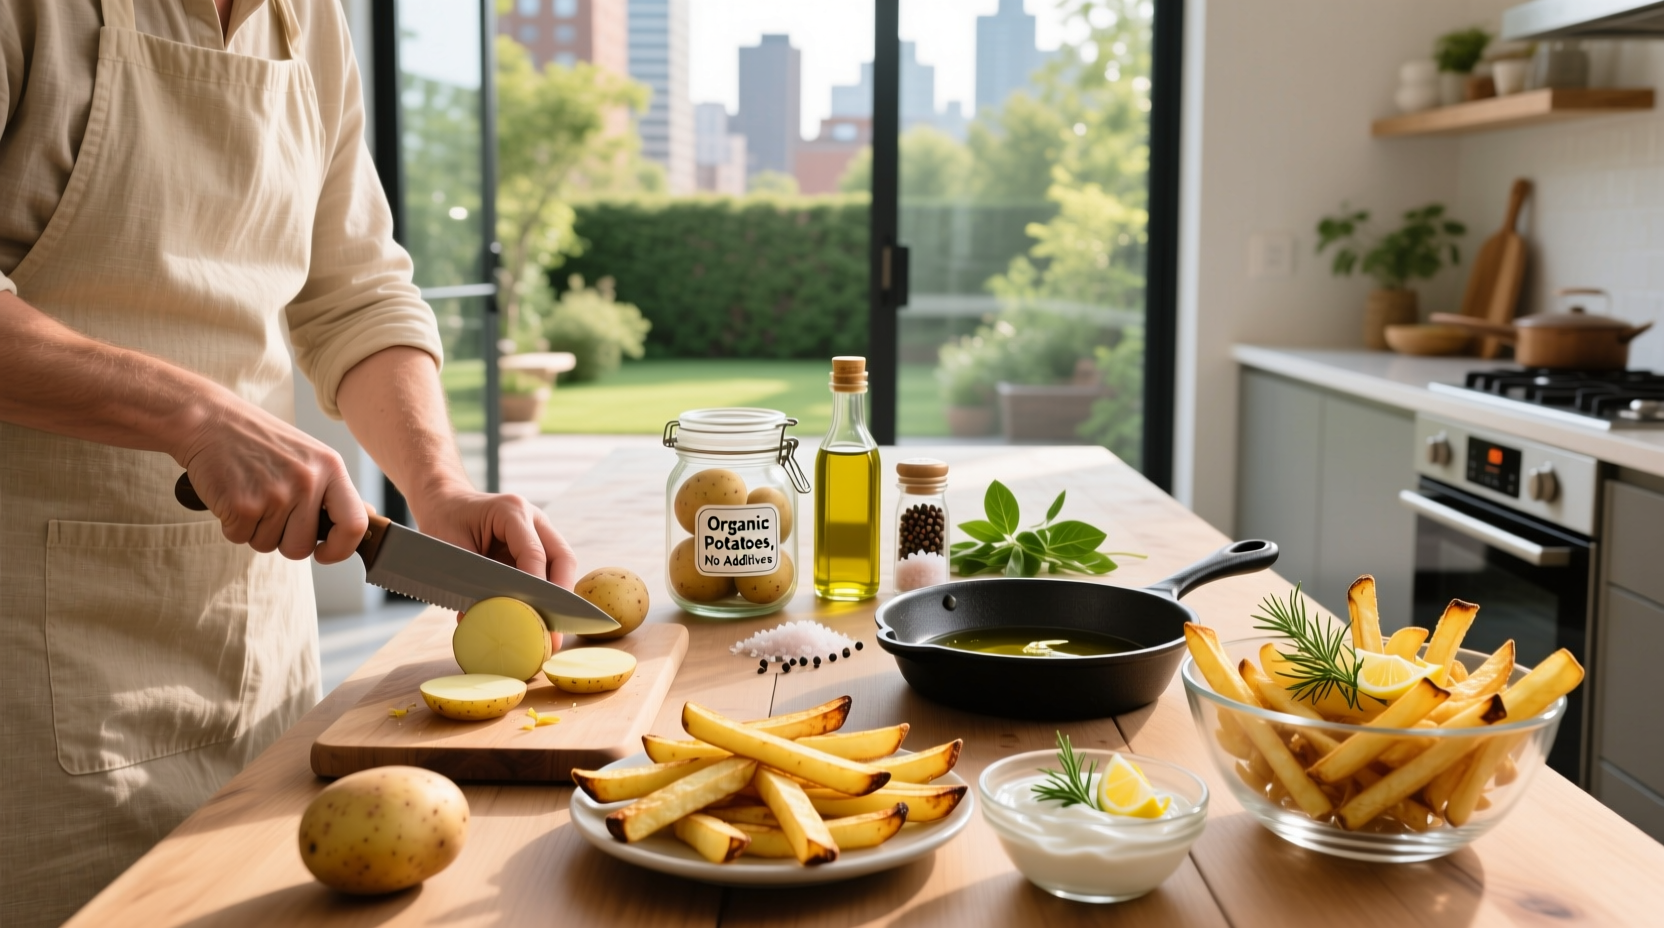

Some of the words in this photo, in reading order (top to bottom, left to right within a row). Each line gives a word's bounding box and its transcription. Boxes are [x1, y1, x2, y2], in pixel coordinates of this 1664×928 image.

[707, 515, 769, 536] Organic
[704, 535, 774, 551] Potatoes,
[704, 554, 720, 566] No
